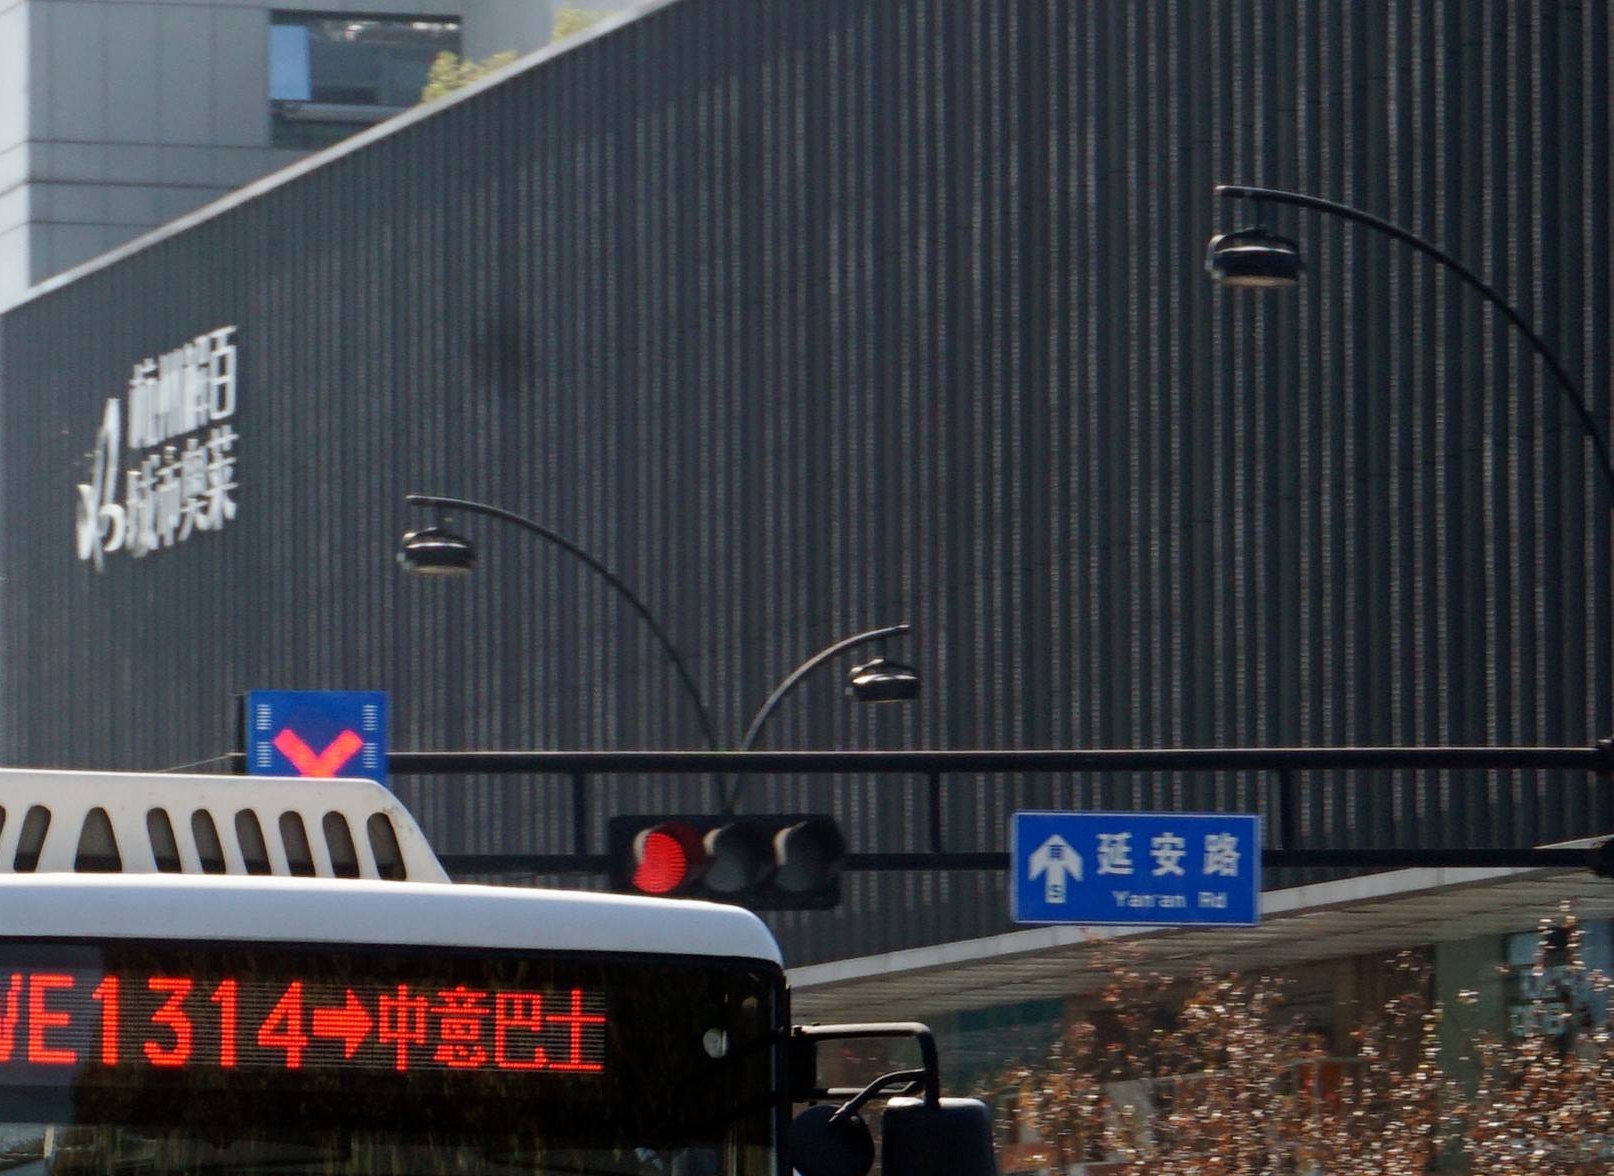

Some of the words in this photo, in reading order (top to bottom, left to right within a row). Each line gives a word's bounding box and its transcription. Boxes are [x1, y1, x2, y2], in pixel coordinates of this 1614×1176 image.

[1096, 832, 1241, 877] 延安路
[1197, 891, 1228, 908] Rd
[378, 984, 606, 1071] 中意巴士
